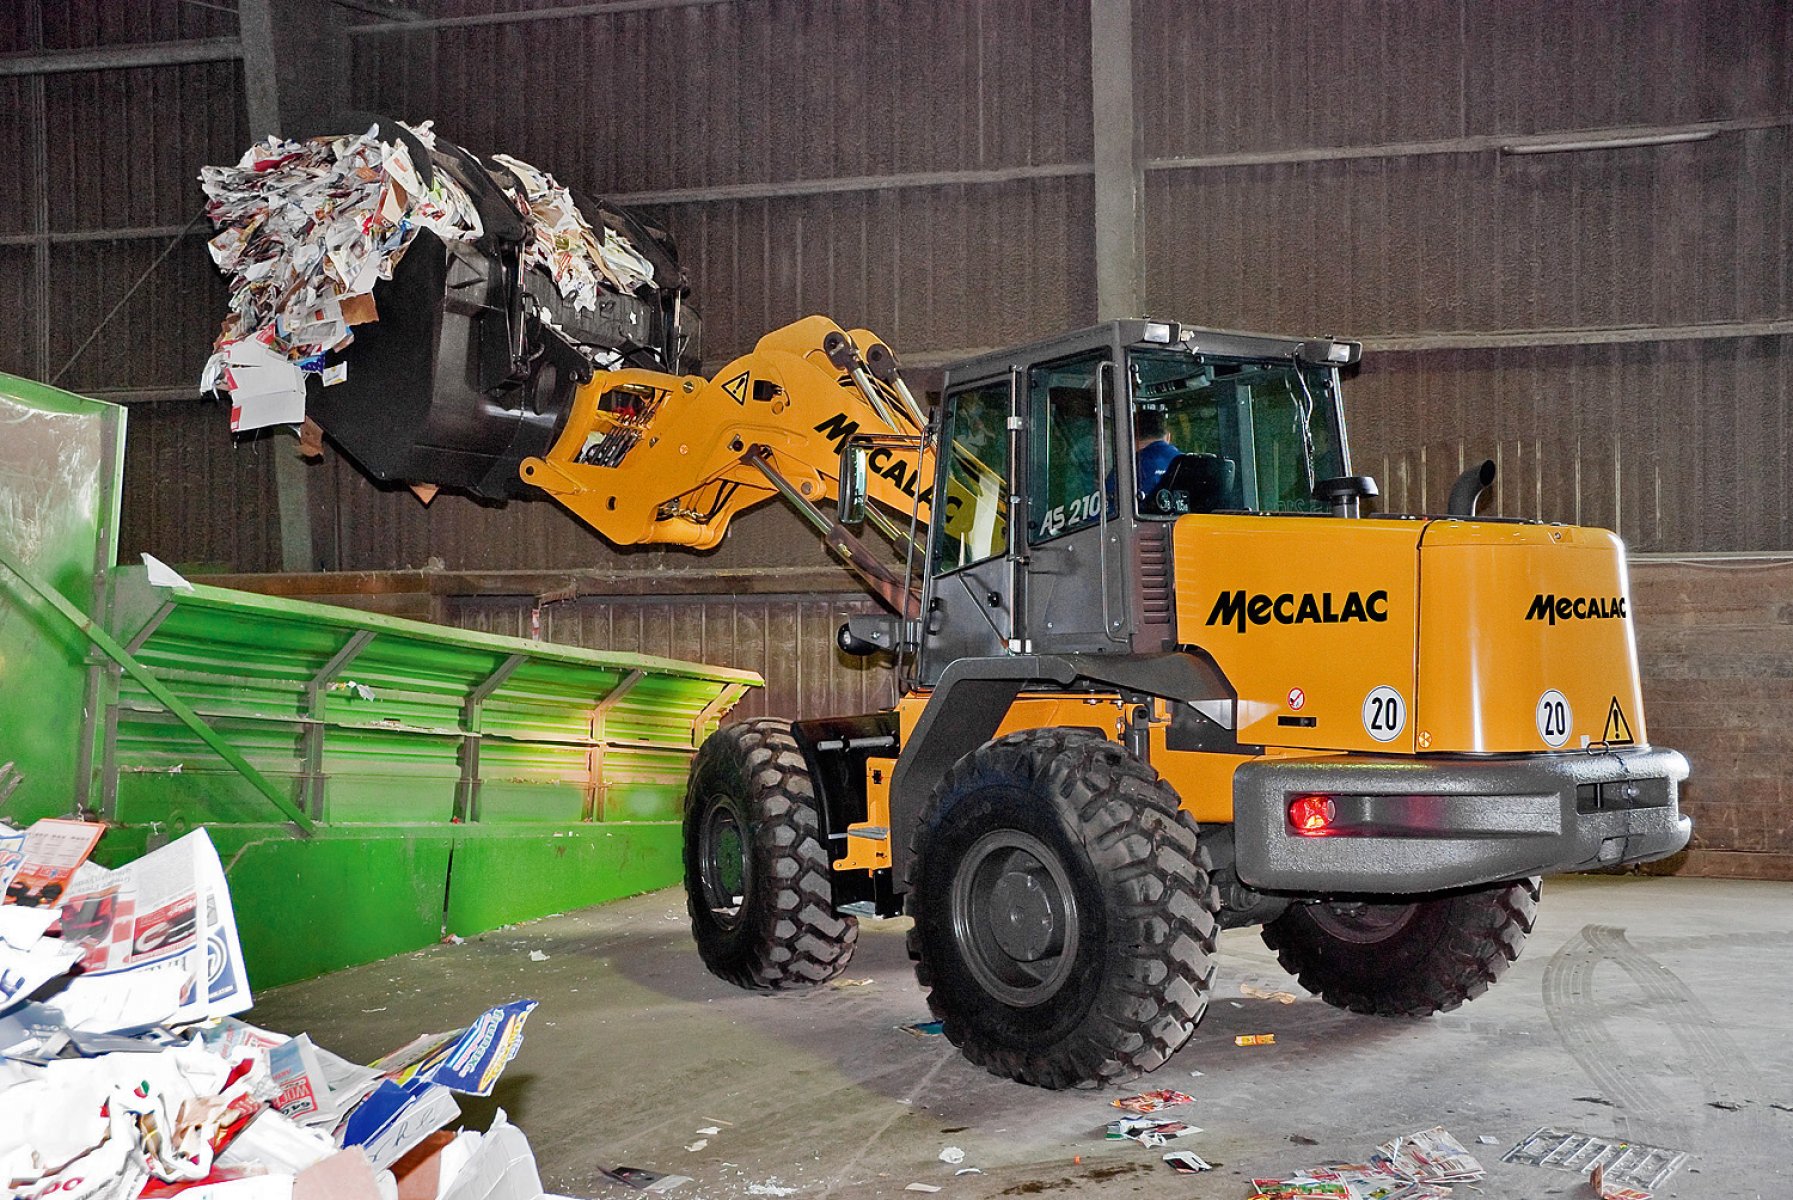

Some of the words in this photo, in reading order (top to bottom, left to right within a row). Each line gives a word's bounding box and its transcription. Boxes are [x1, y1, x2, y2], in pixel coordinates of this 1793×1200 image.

[1039, 505, 1065, 536] AS
[1068, 491, 1101, 526] 210
[1371, 697, 1398, 731] 20
[1544, 701, 1566, 736] 20
